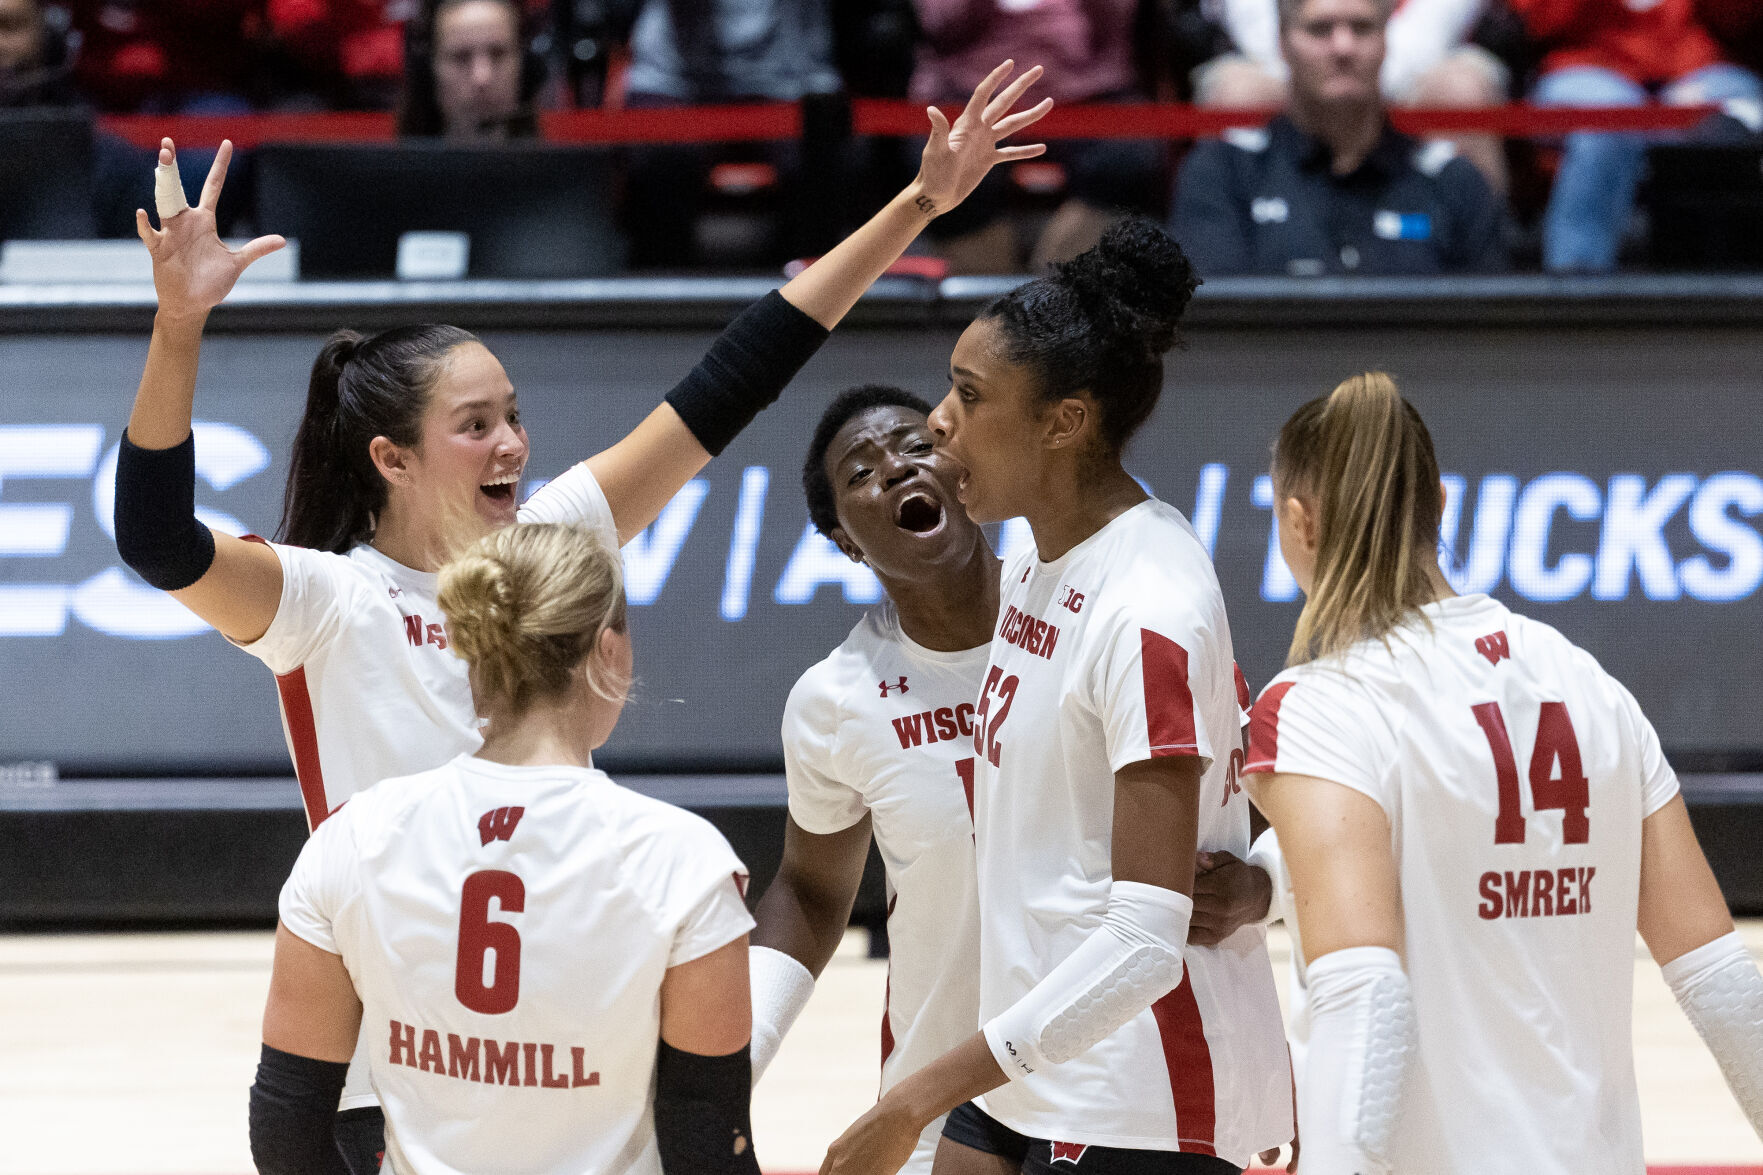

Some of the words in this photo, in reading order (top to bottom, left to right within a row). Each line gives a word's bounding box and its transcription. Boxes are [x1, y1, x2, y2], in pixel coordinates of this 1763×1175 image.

[1251, 471, 1763, 603] UCKS
[973, 664, 1020, 769] 52
[1470, 701, 1590, 845] 14
[477, 806, 525, 847] W
[455, 869, 525, 1015] 6
[1478, 867, 1596, 920] SMREK
[389, 1019, 600, 1089] HAMMILL
